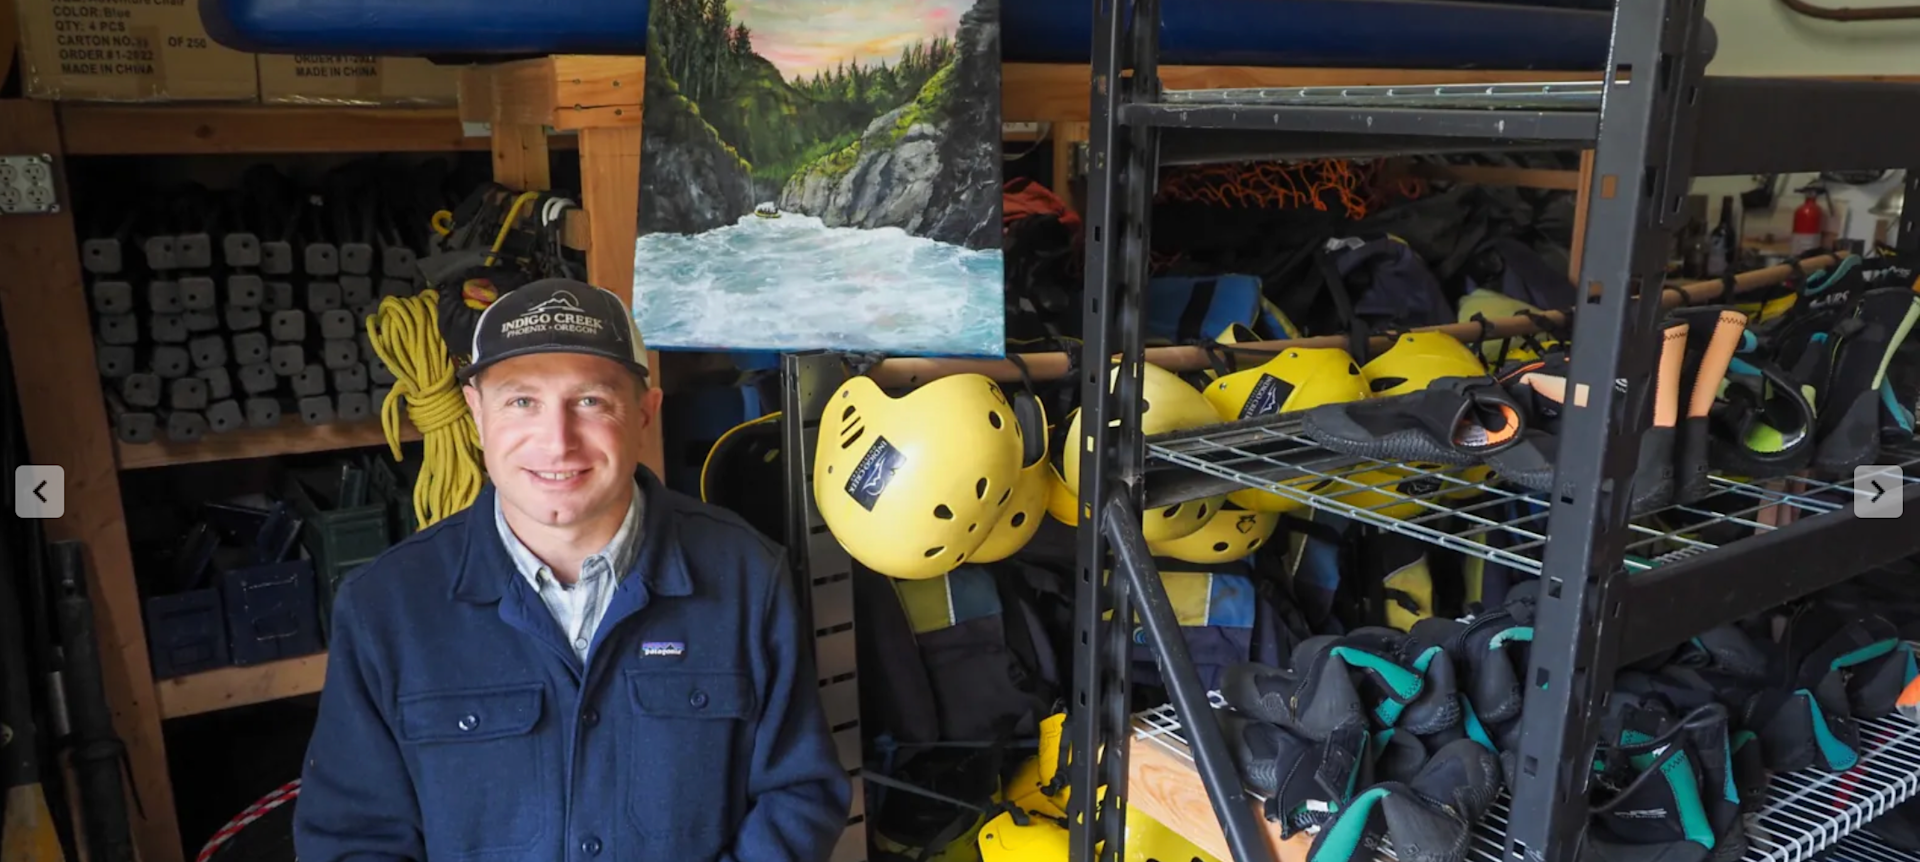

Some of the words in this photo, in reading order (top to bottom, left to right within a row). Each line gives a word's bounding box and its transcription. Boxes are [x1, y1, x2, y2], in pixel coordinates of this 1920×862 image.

[103, 7, 131, 18] Blue
[55, 20, 84, 31] QTY:
[100, 21, 126, 32] PCS
[57, 34, 110, 46] CARTON
[167, 36, 183, 47] OF
[60, 48, 104, 60] ORDER
[61, 63, 98, 75] MADE
[100, 64, 113, 75] IN
[116, 63, 154, 75] CHINA
[296, 66, 328, 77] MADE
[330, 66, 341, 77] IN
[343, 66, 377, 77] CHINA
[501, 313, 551, 333] INDIGO
[554, 313, 603, 330] CREEK
[506, 325, 547, 338] PHOENIX
[554, 324, 598, 335] OREGON
[864, 440, 888, 471] INDIGO
[848, 470, 866, 495] CREEK
